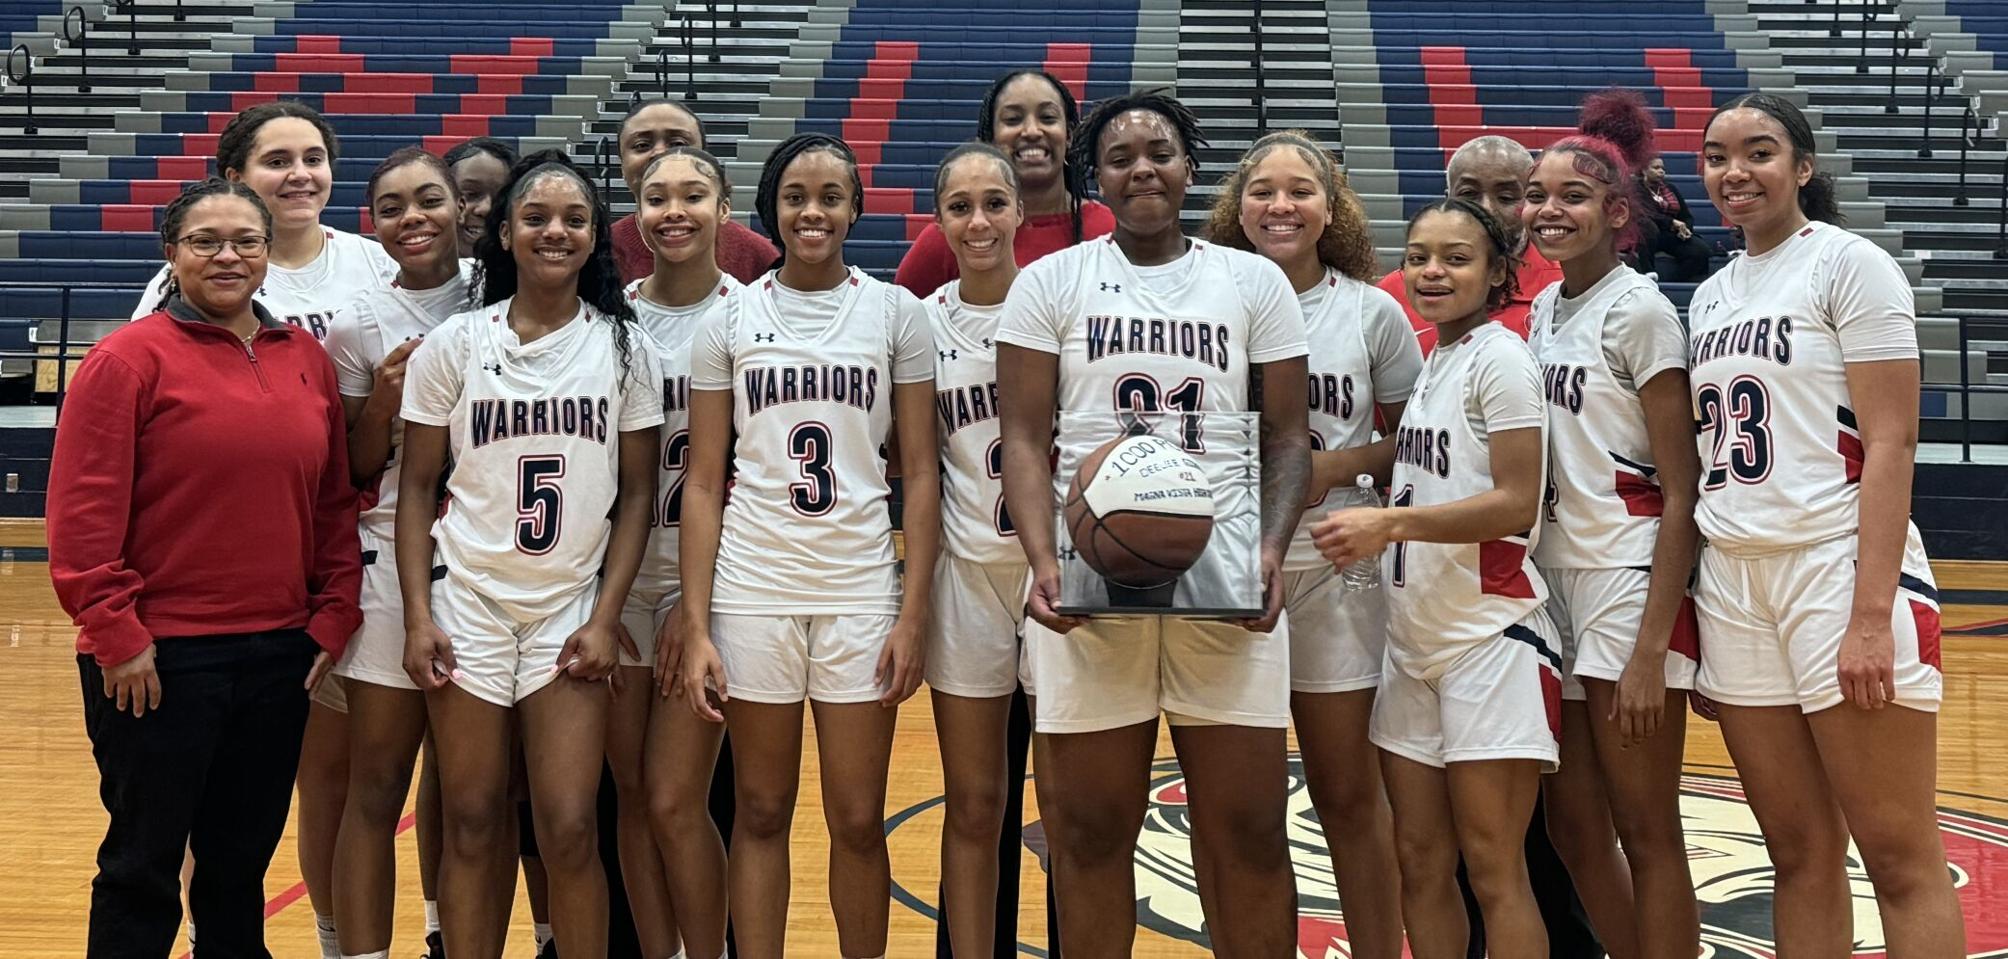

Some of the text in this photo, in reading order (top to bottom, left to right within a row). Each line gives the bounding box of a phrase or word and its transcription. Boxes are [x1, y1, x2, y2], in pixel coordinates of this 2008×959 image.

[1086, 315, 1229, 373] WARRIORS
[1689, 316, 1793, 374] ARRIORS
[744, 364, 877, 418] WARRIORS
[472, 396, 608, 448] WARRIORS
[1697, 374, 1774, 491] 23
[788, 421, 837, 517] 3
[515, 454, 566, 556] 5
